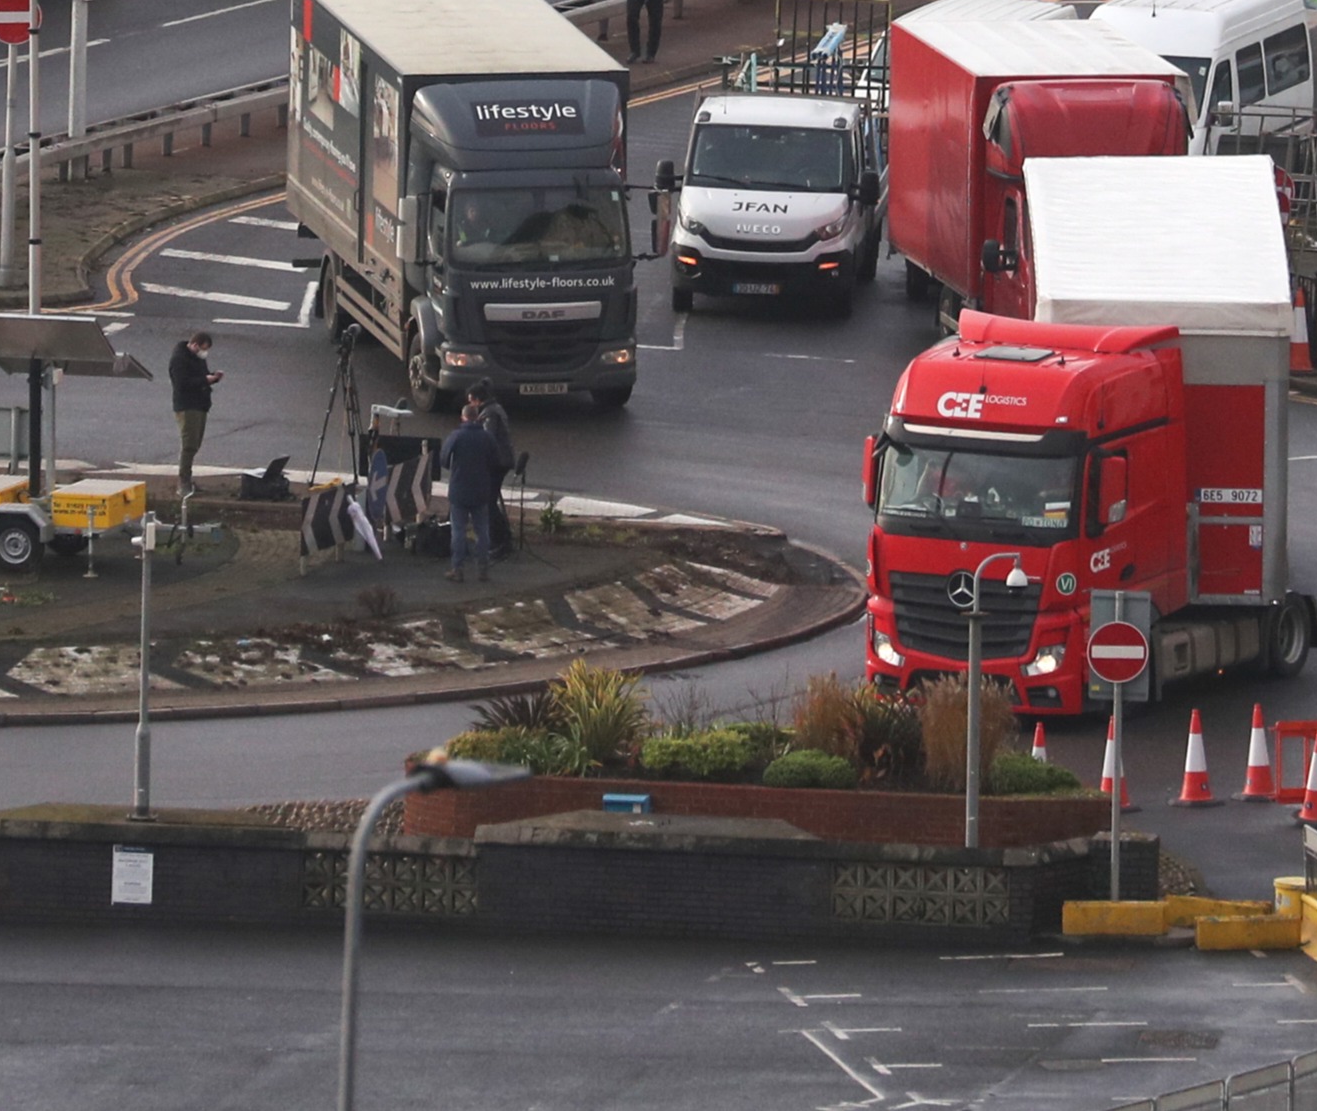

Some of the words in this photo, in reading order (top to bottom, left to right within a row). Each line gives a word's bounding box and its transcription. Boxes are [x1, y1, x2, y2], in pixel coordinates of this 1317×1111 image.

[476, 103, 577, 121] lifestyle
[732, 201, 788, 214] JFAN
[737, 224, 781, 234] IVECO
[470, 276, 615, 291] www.lifestyle-floors.co.uk
[522, 311, 565, 319] DAF
[937, 391, 985, 419] CEE
[985, 394, 1027, 406] LOGISTICS
[1203, 490, 1223, 501] 6E5
[1231, 490, 1258, 501] 9072
[1090, 549, 1111, 572] CEE
[1060, 578, 1072, 590] VI
